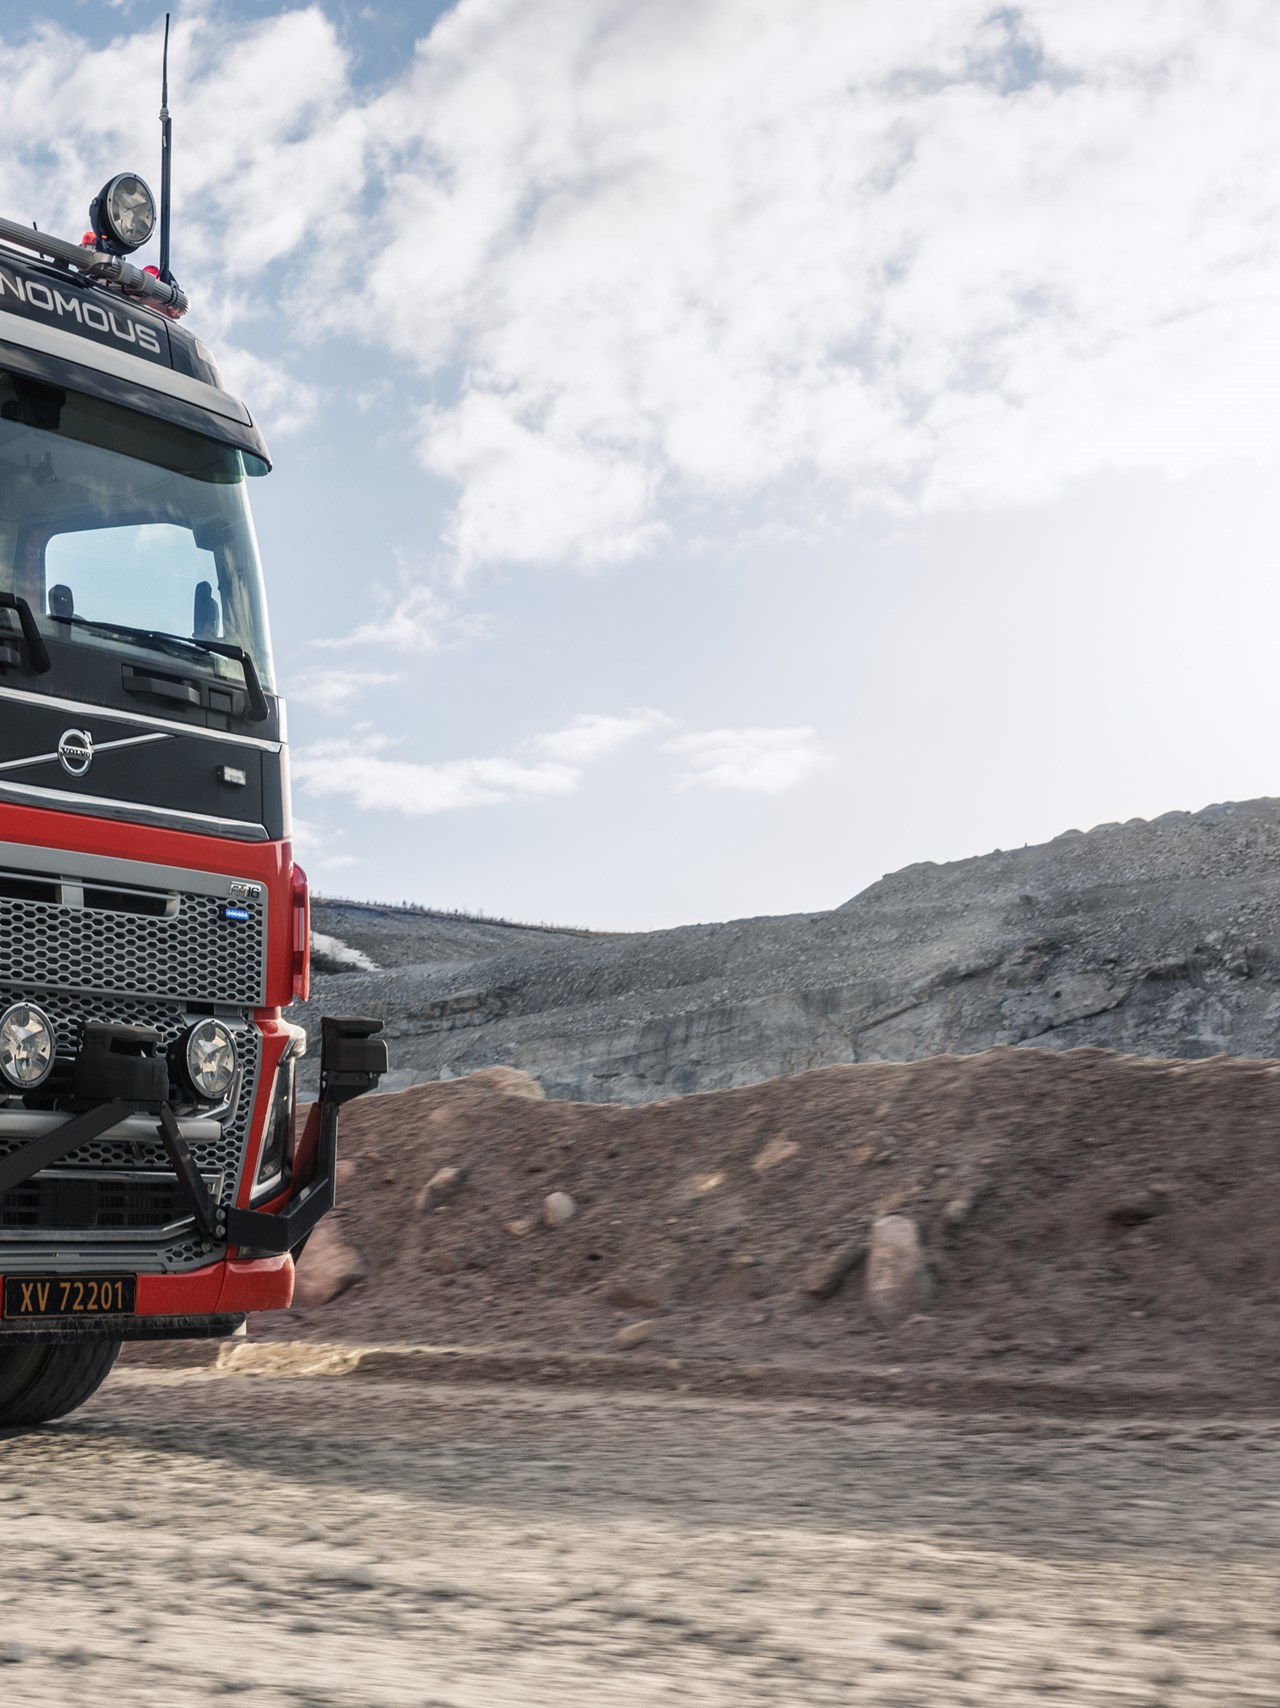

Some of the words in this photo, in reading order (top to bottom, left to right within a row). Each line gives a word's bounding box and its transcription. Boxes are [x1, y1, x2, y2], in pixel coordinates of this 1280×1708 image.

[61, 746, 91, 760] VOLVO
[20, 1282, 50, 1312] XV
[60, 1281, 122, 1311] 72201
